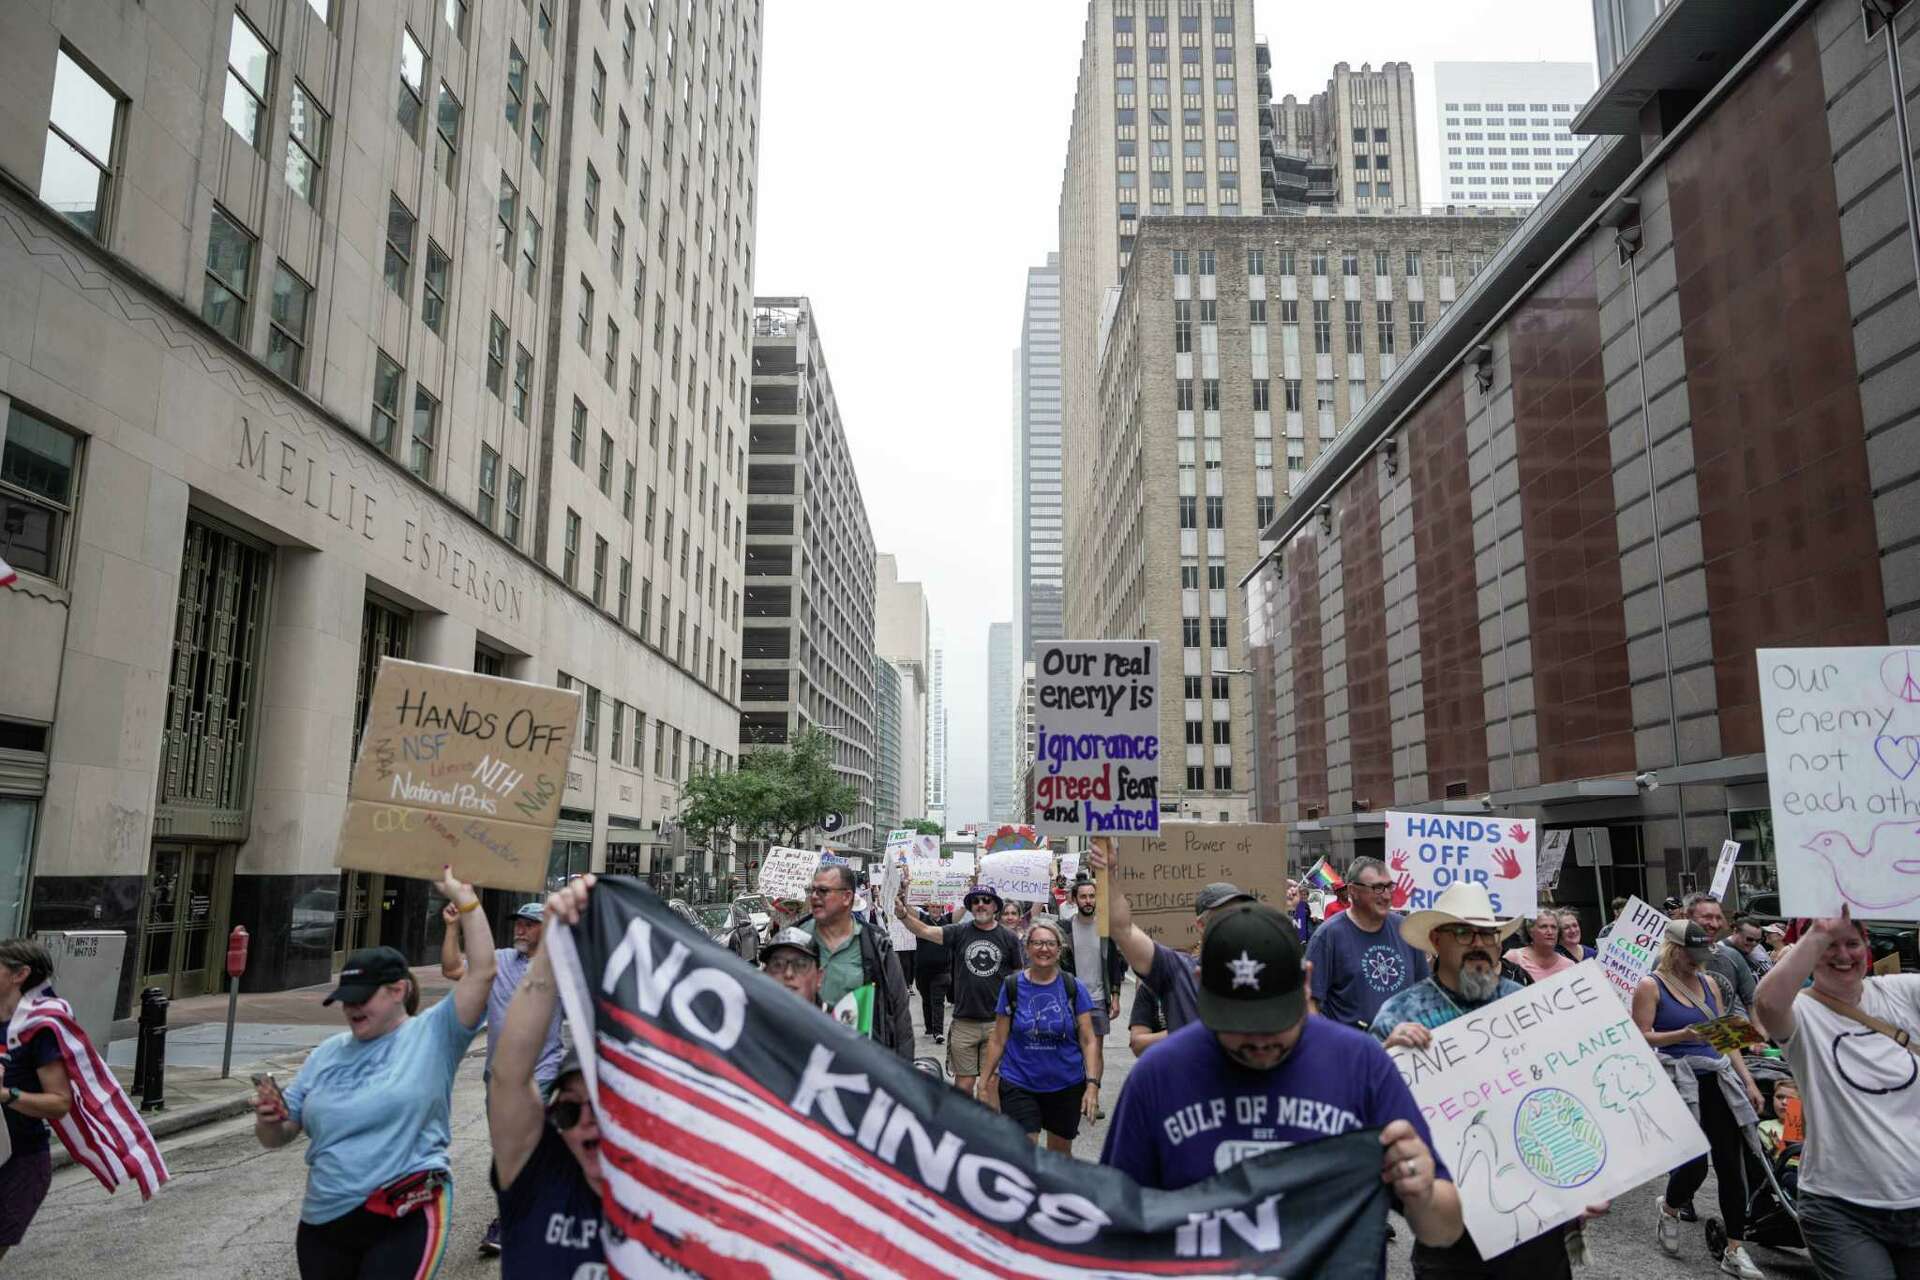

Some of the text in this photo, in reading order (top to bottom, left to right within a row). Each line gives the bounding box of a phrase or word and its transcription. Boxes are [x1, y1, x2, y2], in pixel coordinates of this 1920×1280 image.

[236, 416, 522, 623] MELLIE ESPERSON
[1043, 646, 1151, 677] Our real
[1040, 679, 1153, 717] enemy is
[396, 689, 566, 755] HANDS OFF
[1776, 707, 1895, 736] enemy
[402, 732, 448, 761] NSF
[1037, 725, 1158, 774] ignorance
[1789, 749, 1849, 772] not
[472, 754, 524, 797] NIH
[1036, 763, 1158, 811] greed fear
[391, 771, 497, 815] National Parks
[1783, 781, 1857, 815] each
[1043, 800, 1158, 832] and hatred
[1407, 817, 1502, 843] HANDS
[1185, 831, 1226, 852] Power
[1237, 837, 1253, 855] of
[1419, 843, 1469, 865] OFF
[1124, 863, 1233, 881] the PEOPLE is
[1433, 867, 1489, 890] OUR
[1124, 891, 1200, 909] STRONGE
[1394, 976, 1600, 1089] SAVE SCIENCE
[1419, 1018, 1633, 1121] PEOPLE & PLANET
[1501, 1041, 1527, 1065] for
[602, 916, 1284, 1257] NO KINGS IN
[1163, 1096, 1363, 1145] GULF OF MEXIC
